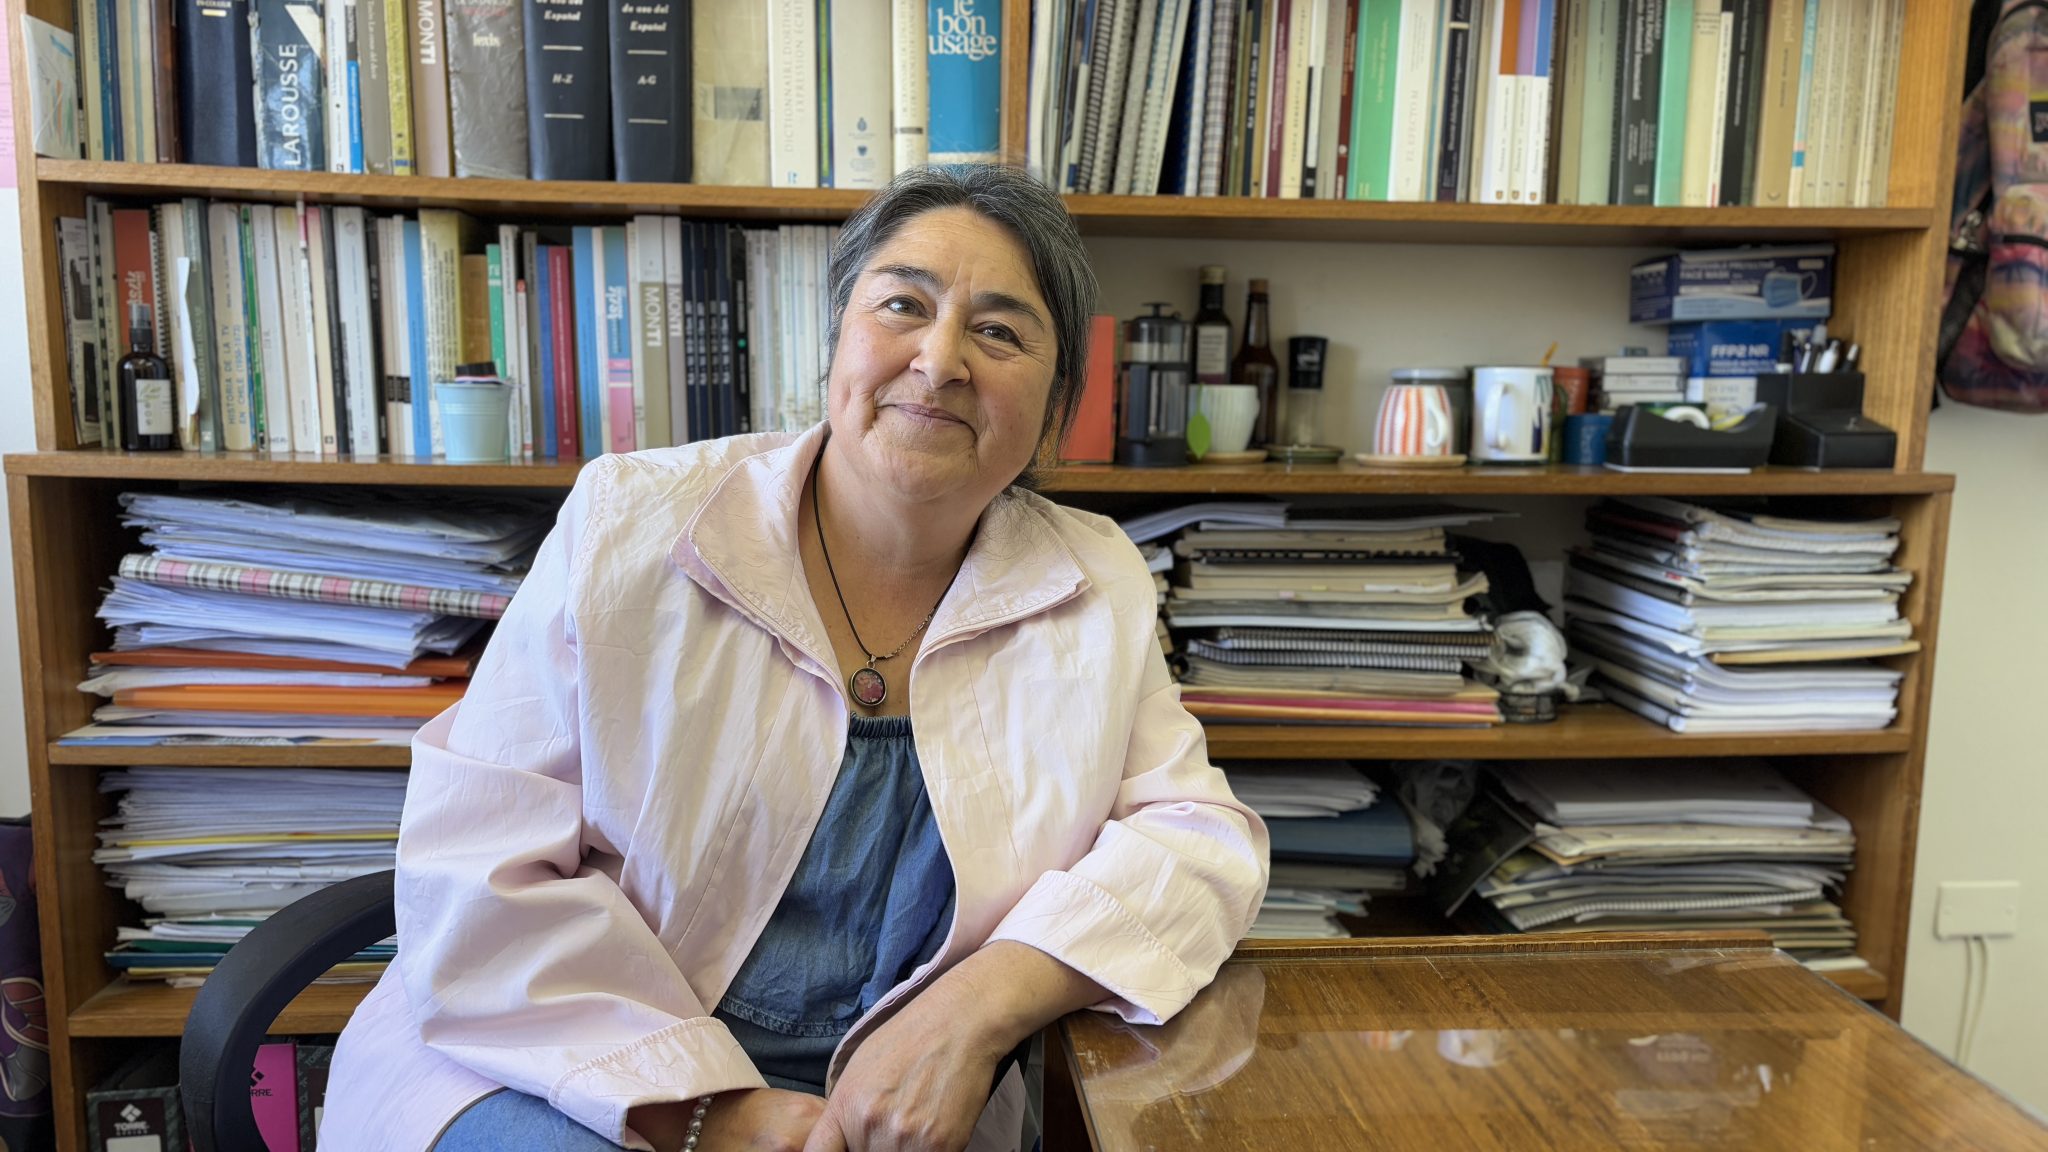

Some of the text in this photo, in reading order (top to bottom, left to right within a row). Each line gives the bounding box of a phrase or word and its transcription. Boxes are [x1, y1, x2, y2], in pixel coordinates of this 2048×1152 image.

[544, 10, 581, 22] Español
[622, 4, 634, 14] de
[653, 4, 670, 14] del
[953, 0, 974, 16] le
[417, 0, 436, 64] MONTI
[630, 21, 668, 32] Español
[937, 8, 986, 35] bon
[928, 33, 998, 61] usage
[552, 74, 574, 84] H-Z
[637, 75, 658, 85] A-G
[795, 39, 805, 112] EXPRESSION
[279, 45, 301, 165] LAROUSSE
[783, 60, 794, 152] DICTIONNAIRE
[645, 287, 662, 346] MONTI
[668, 288, 682, 337] MONTI
[1711, 343, 1770, 358] FFP2 NR
[221, 325, 236, 424] HISTORIA DE LA TV
[235, 378, 245, 405] CHILE
[237, 411, 247, 424] EN
[250, 1088, 272, 1097] RRE
[114, 1121, 147, 1131] TORRE
